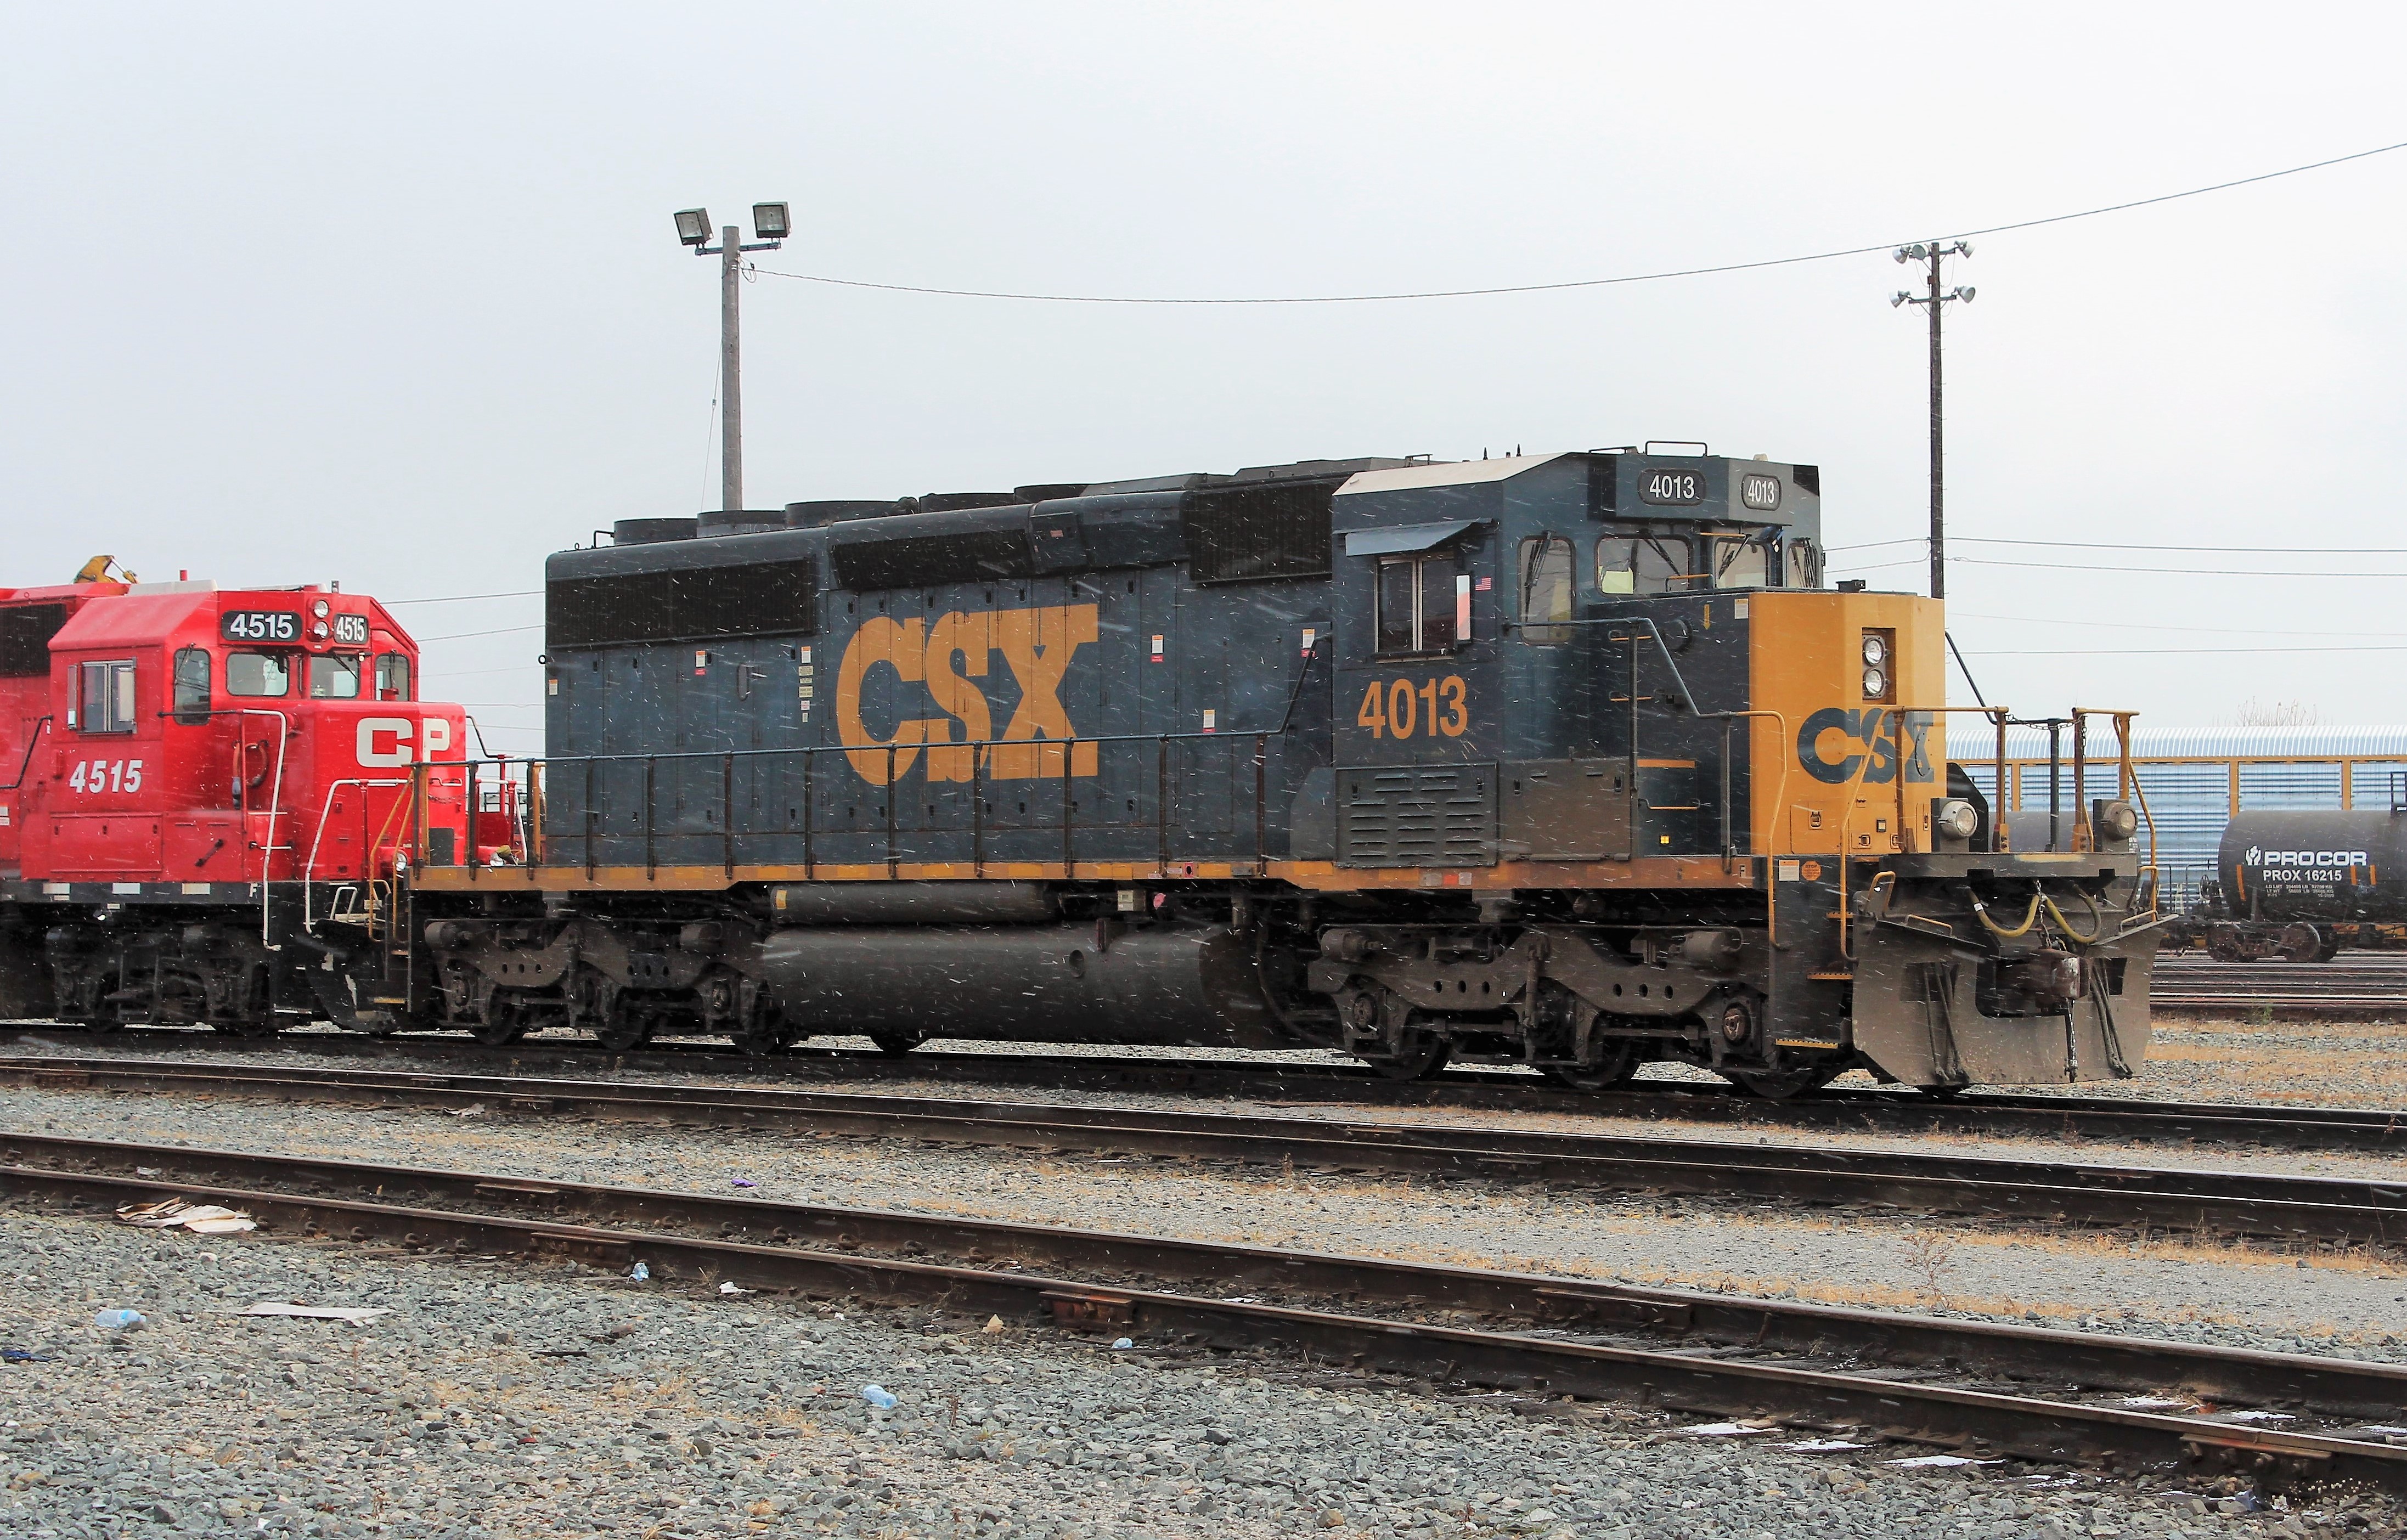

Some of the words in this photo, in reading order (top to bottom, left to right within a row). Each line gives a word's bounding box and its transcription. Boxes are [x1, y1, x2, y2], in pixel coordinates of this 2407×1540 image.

[1649, 475, 1695, 499] 4013
[1748, 479, 1775, 504] 4013
[230, 613, 293, 639] 4515
[336, 616, 365, 642] 4515
[837, 604, 1098, 785] CSX
[1358, 675, 1468, 740] 4013
[356, 717, 451, 768] CP
[1797, 707, 1935, 784] CSX
[70, 760, 143, 793] 4515
[1739, 865, 1745, 877] F
[2264, 851, 2367, 866] PROCOR
[2263, 870, 2302, 882] PROX
[2304, 870, 2342, 882] 16215
[249, 883, 258, 898] F
